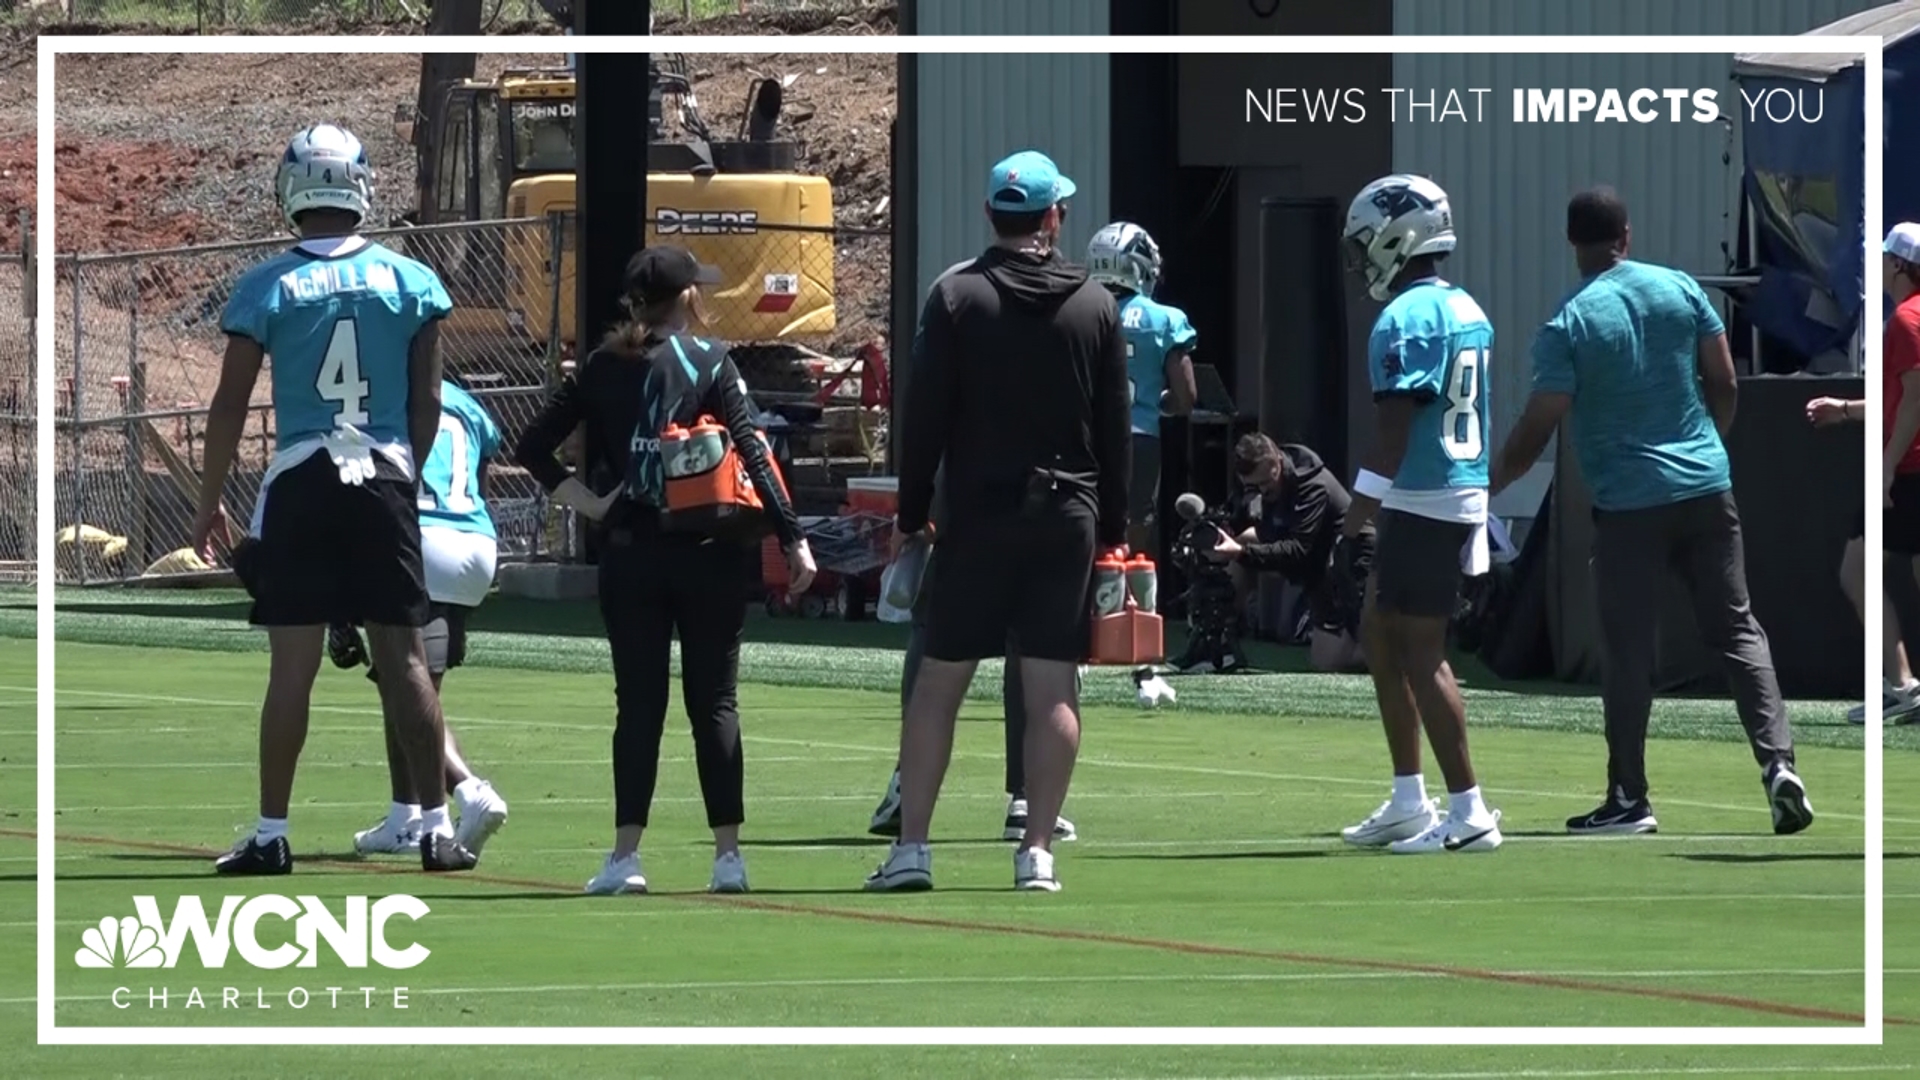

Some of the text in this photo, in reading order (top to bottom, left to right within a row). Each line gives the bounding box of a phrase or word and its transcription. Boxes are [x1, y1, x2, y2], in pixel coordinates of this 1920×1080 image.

[516, 104, 557, 118] JOHN
[322, 168, 332, 184] 4
[656, 208, 757, 234] DEERE
[315, 317, 371, 427] 4
